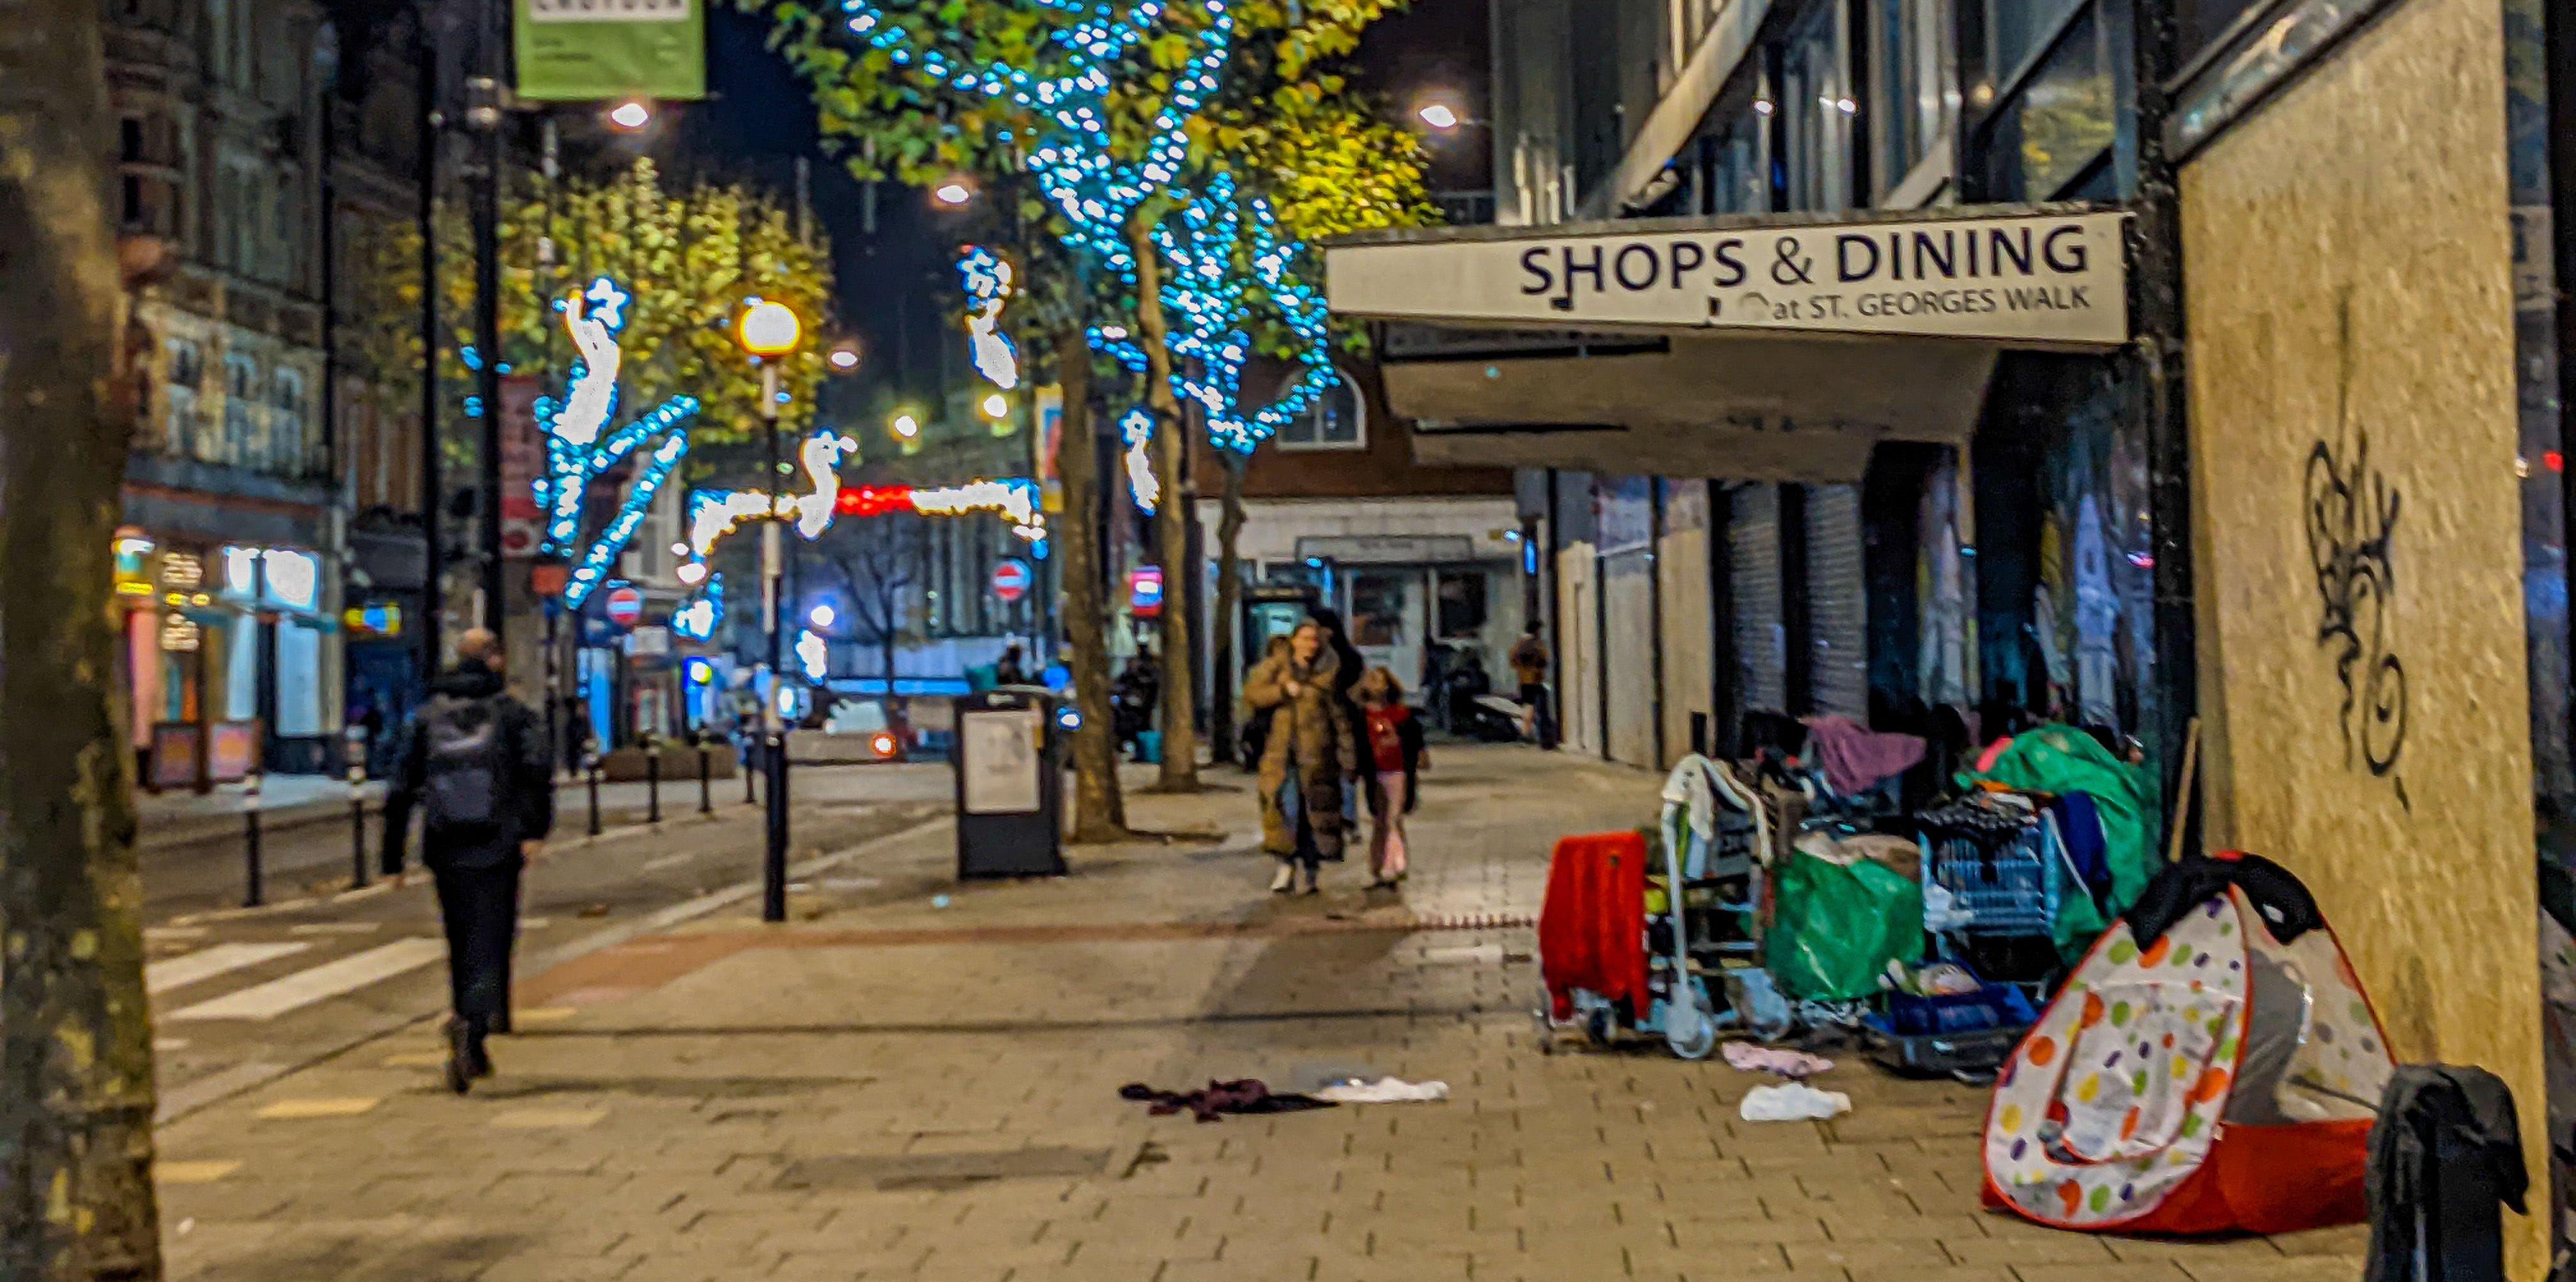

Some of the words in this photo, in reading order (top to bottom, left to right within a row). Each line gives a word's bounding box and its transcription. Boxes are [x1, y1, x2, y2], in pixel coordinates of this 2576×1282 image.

[1521, 238, 1746, 295] SHOPS
[1772, 236, 1814, 285] &
[1837, 224, 2087, 282] DINING
[1773, 299, 1800, 320] at
[1810, 295, 1848, 319] ST.
[1857, 289, 1997, 316] GEORGES
[2005, 285, 2090, 311] WALK
